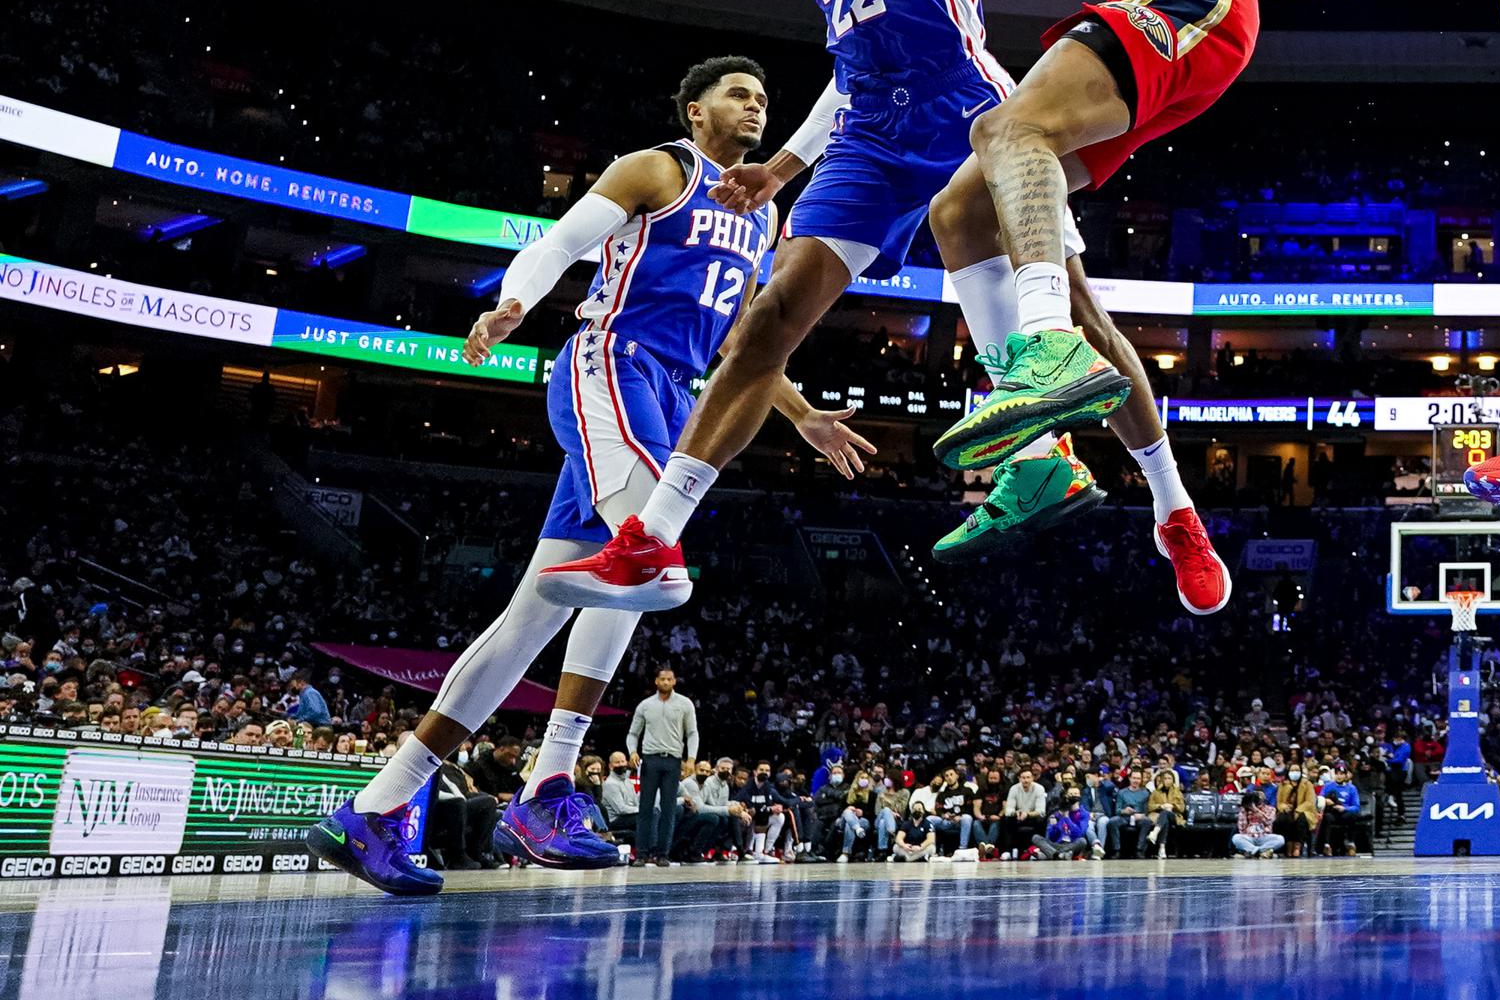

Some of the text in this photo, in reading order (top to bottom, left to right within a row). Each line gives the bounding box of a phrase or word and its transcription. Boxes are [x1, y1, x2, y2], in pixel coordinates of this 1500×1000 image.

[145, 150, 380, 215] AUTO. HOME. RENTERS.
[685, 208, 767, 271] PHILA
[23, 269, 118, 309] JINGLES
[138, 294, 253, 333] MASCOTS
[698, 259, 746, 318] 12
[1218, 293, 1410, 307] AUTO. HOME. RENTERS.
[300, 325, 350, 346] JUST
[358, 334, 419, 357] GREAT
[427, 345, 538, 373] INSANCE
[1178, 406, 1297, 422] PHILADELPHIA 76ERS
[1326, 401, 1361, 426] 44
[1452, 429, 1492, 450] 2:03
[64, 777, 135, 838] NJM
[134, 781, 185, 803] Insurance
[200, 776, 305, 822] NO JINGLES
[129, 807, 162, 832] Group
[248, 827, 296, 841] JUST GREAT
[0, 856, 57, 878] GEICO
[60, 855, 112, 876] GEICO
[119, 855, 166, 875] GEICO
[171, 854, 216, 874] GEICO
[222, 854, 264, 873] GEICO
[272, 853, 310, 872] GEICO
